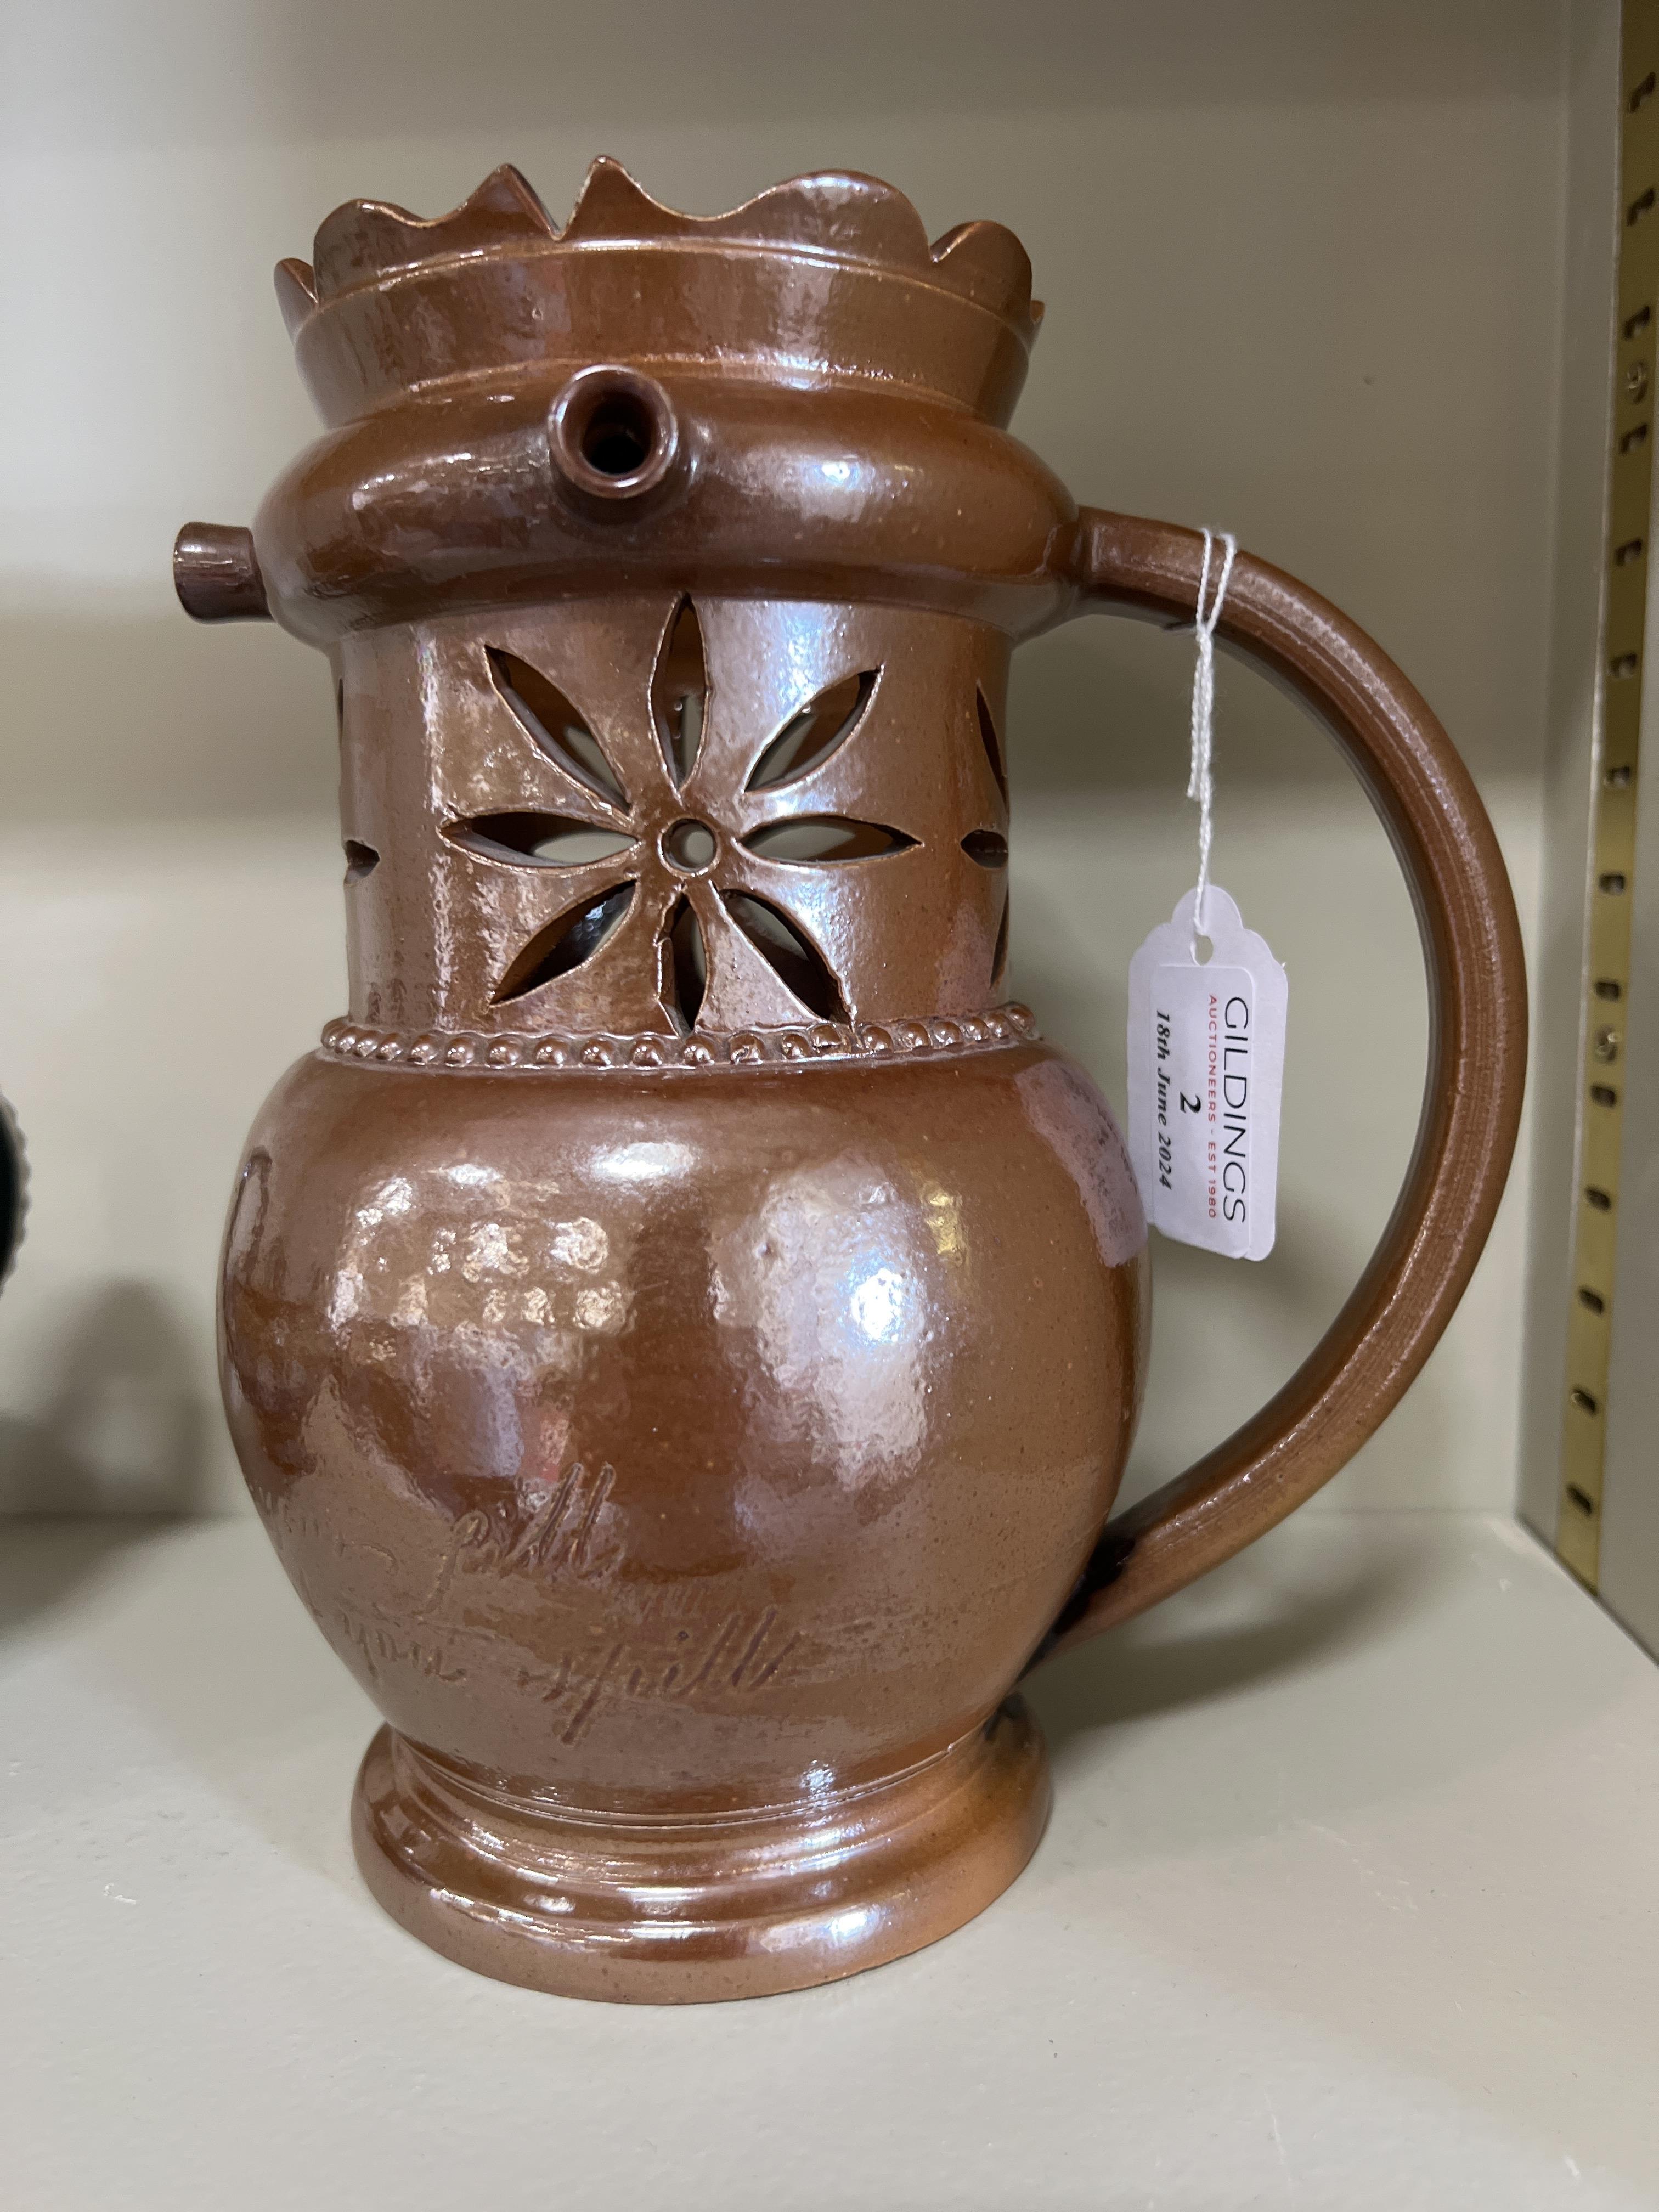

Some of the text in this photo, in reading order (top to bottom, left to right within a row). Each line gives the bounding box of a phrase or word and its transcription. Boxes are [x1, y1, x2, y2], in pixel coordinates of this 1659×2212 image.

[1156, 1009, 1172, 1190] 18th June 2024
[1207, 994, 1217, 1122] AUCTIONEERS
[1180, 1091, 1201, 1114] 2
[1223, 996, 1249, 1223] GILDINGS
[1207, 1142, 1216, 1173] EST
[1207, 1180, 1217, 1218] 1980
